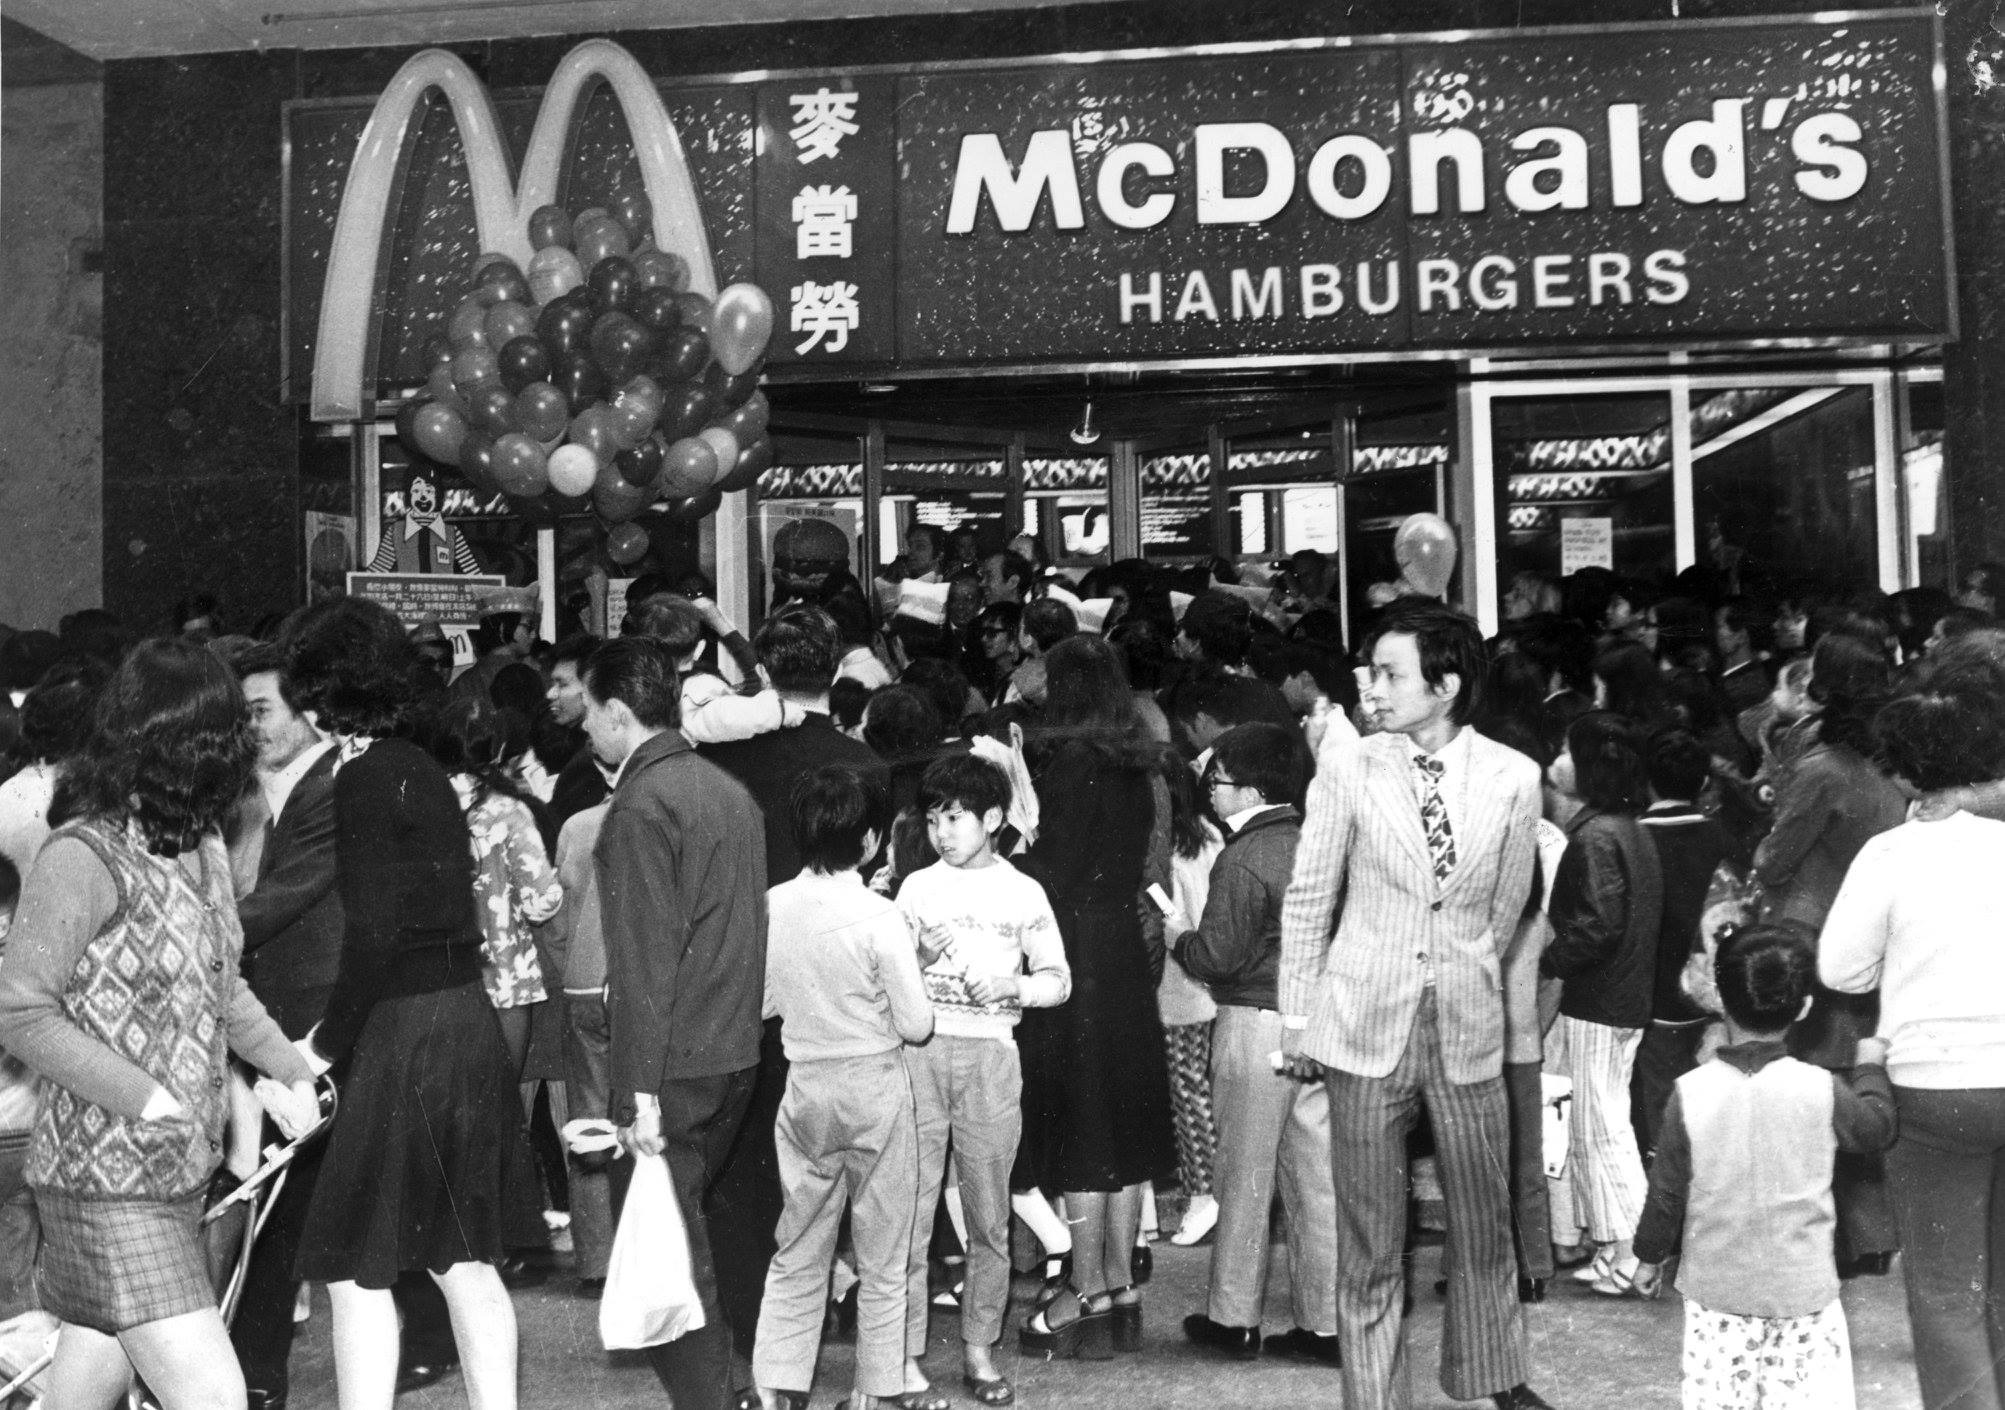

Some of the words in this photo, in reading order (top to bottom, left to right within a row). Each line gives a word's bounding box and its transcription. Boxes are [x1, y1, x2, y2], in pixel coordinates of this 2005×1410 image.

[789, 88, 859, 354] 麥當勞
[946, 97, 1868, 234] McDonald's
[1119, 249, 1690, 324] HAMBURGERS
